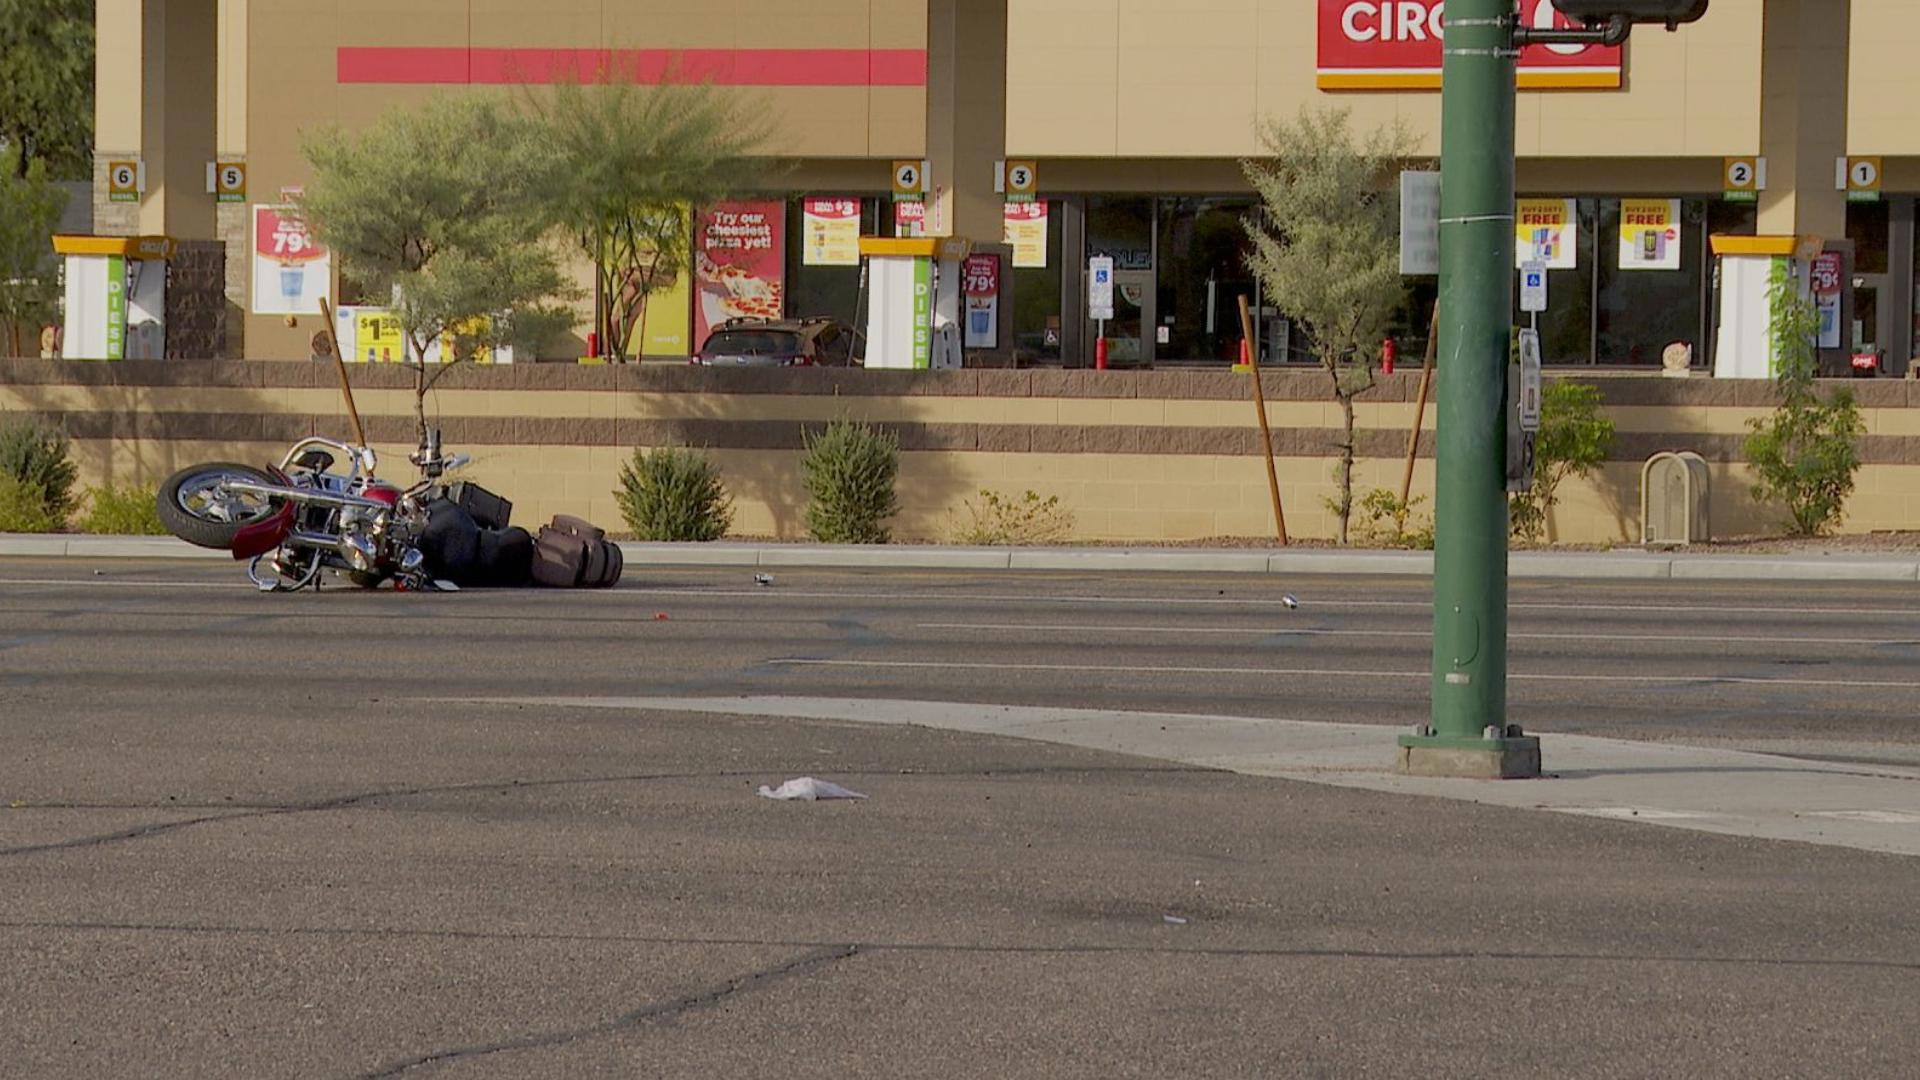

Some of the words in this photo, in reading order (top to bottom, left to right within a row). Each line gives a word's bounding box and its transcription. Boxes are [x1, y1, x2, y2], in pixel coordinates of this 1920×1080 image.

[119, 170, 128, 183] 6
[227, 170, 236, 184] 5
[902, 169, 913, 183] 4
[1015, 170, 1026, 184] 3
[1735, 167, 1746, 181] 2
[1859, 167, 1867, 181] 1
[836, 200, 853, 216] $3
[1023, 202, 1041, 218] $5
[714, 211, 738, 225] Try
[740, 213, 764, 224] our
[1524, 214, 1560, 225] FREE
[1626, 214, 1664, 225] FREE
[706, 223, 771, 236] cheesiest
[705, 236, 742, 250] pizza
[744, 236, 772, 250] yet!
[967, 275, 995, 291] 79¢
[109, 282, 120, 355] DIESE
